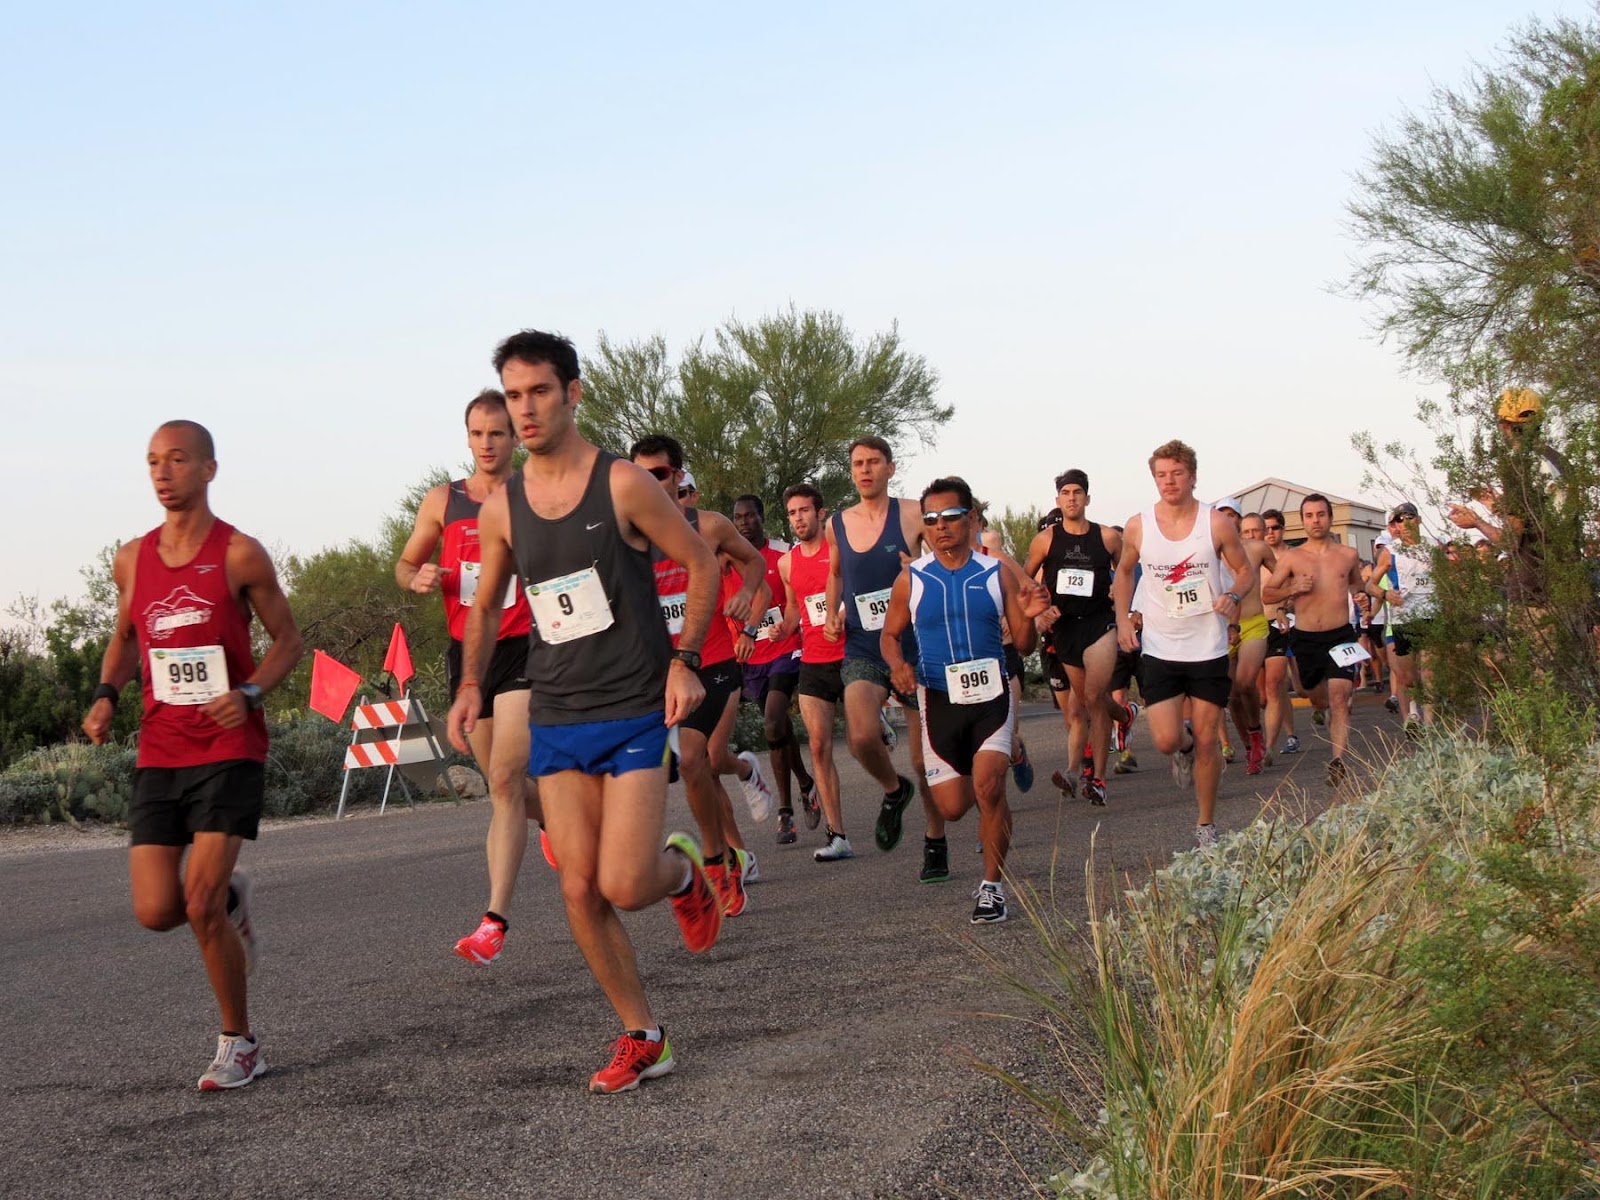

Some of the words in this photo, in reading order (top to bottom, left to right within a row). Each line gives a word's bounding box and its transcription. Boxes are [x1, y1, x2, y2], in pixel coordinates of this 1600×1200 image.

[1067, 575, 1084, 587] 123
[557, 592, 574, 616] 9
[1176, 589, 1198, 604] 715
[169, 661, 208, 684] 998
[960, 670, 989, 689] 996
